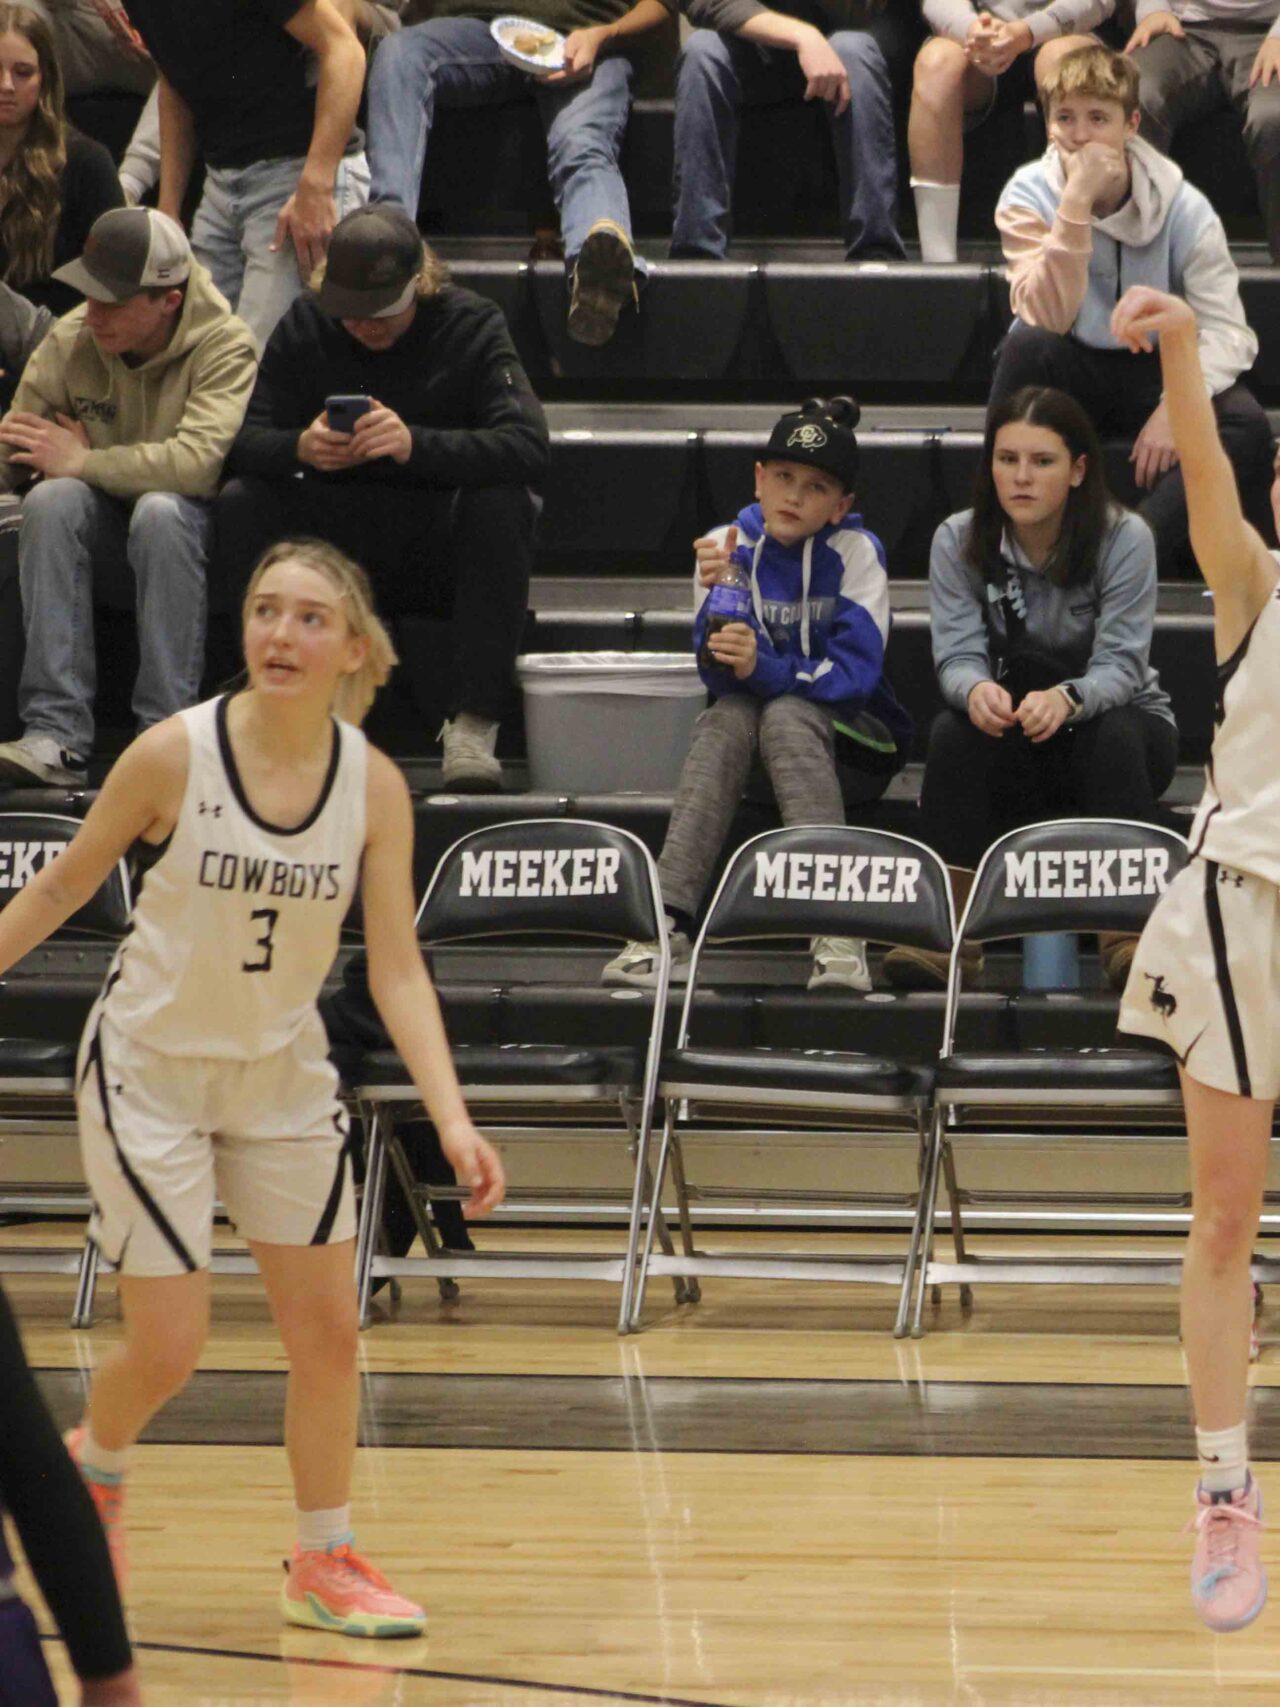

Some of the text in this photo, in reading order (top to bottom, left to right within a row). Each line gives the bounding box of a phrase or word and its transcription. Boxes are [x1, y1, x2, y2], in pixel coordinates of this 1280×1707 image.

[199, 850, 341, 901] COWBOYS
[459, 848, 621, 897] MEEKER
[753, 851, 922, 903] MEEKER
[1004, 848, 1170, 898] MEEKER
[242, 908, 280, 973] 3
